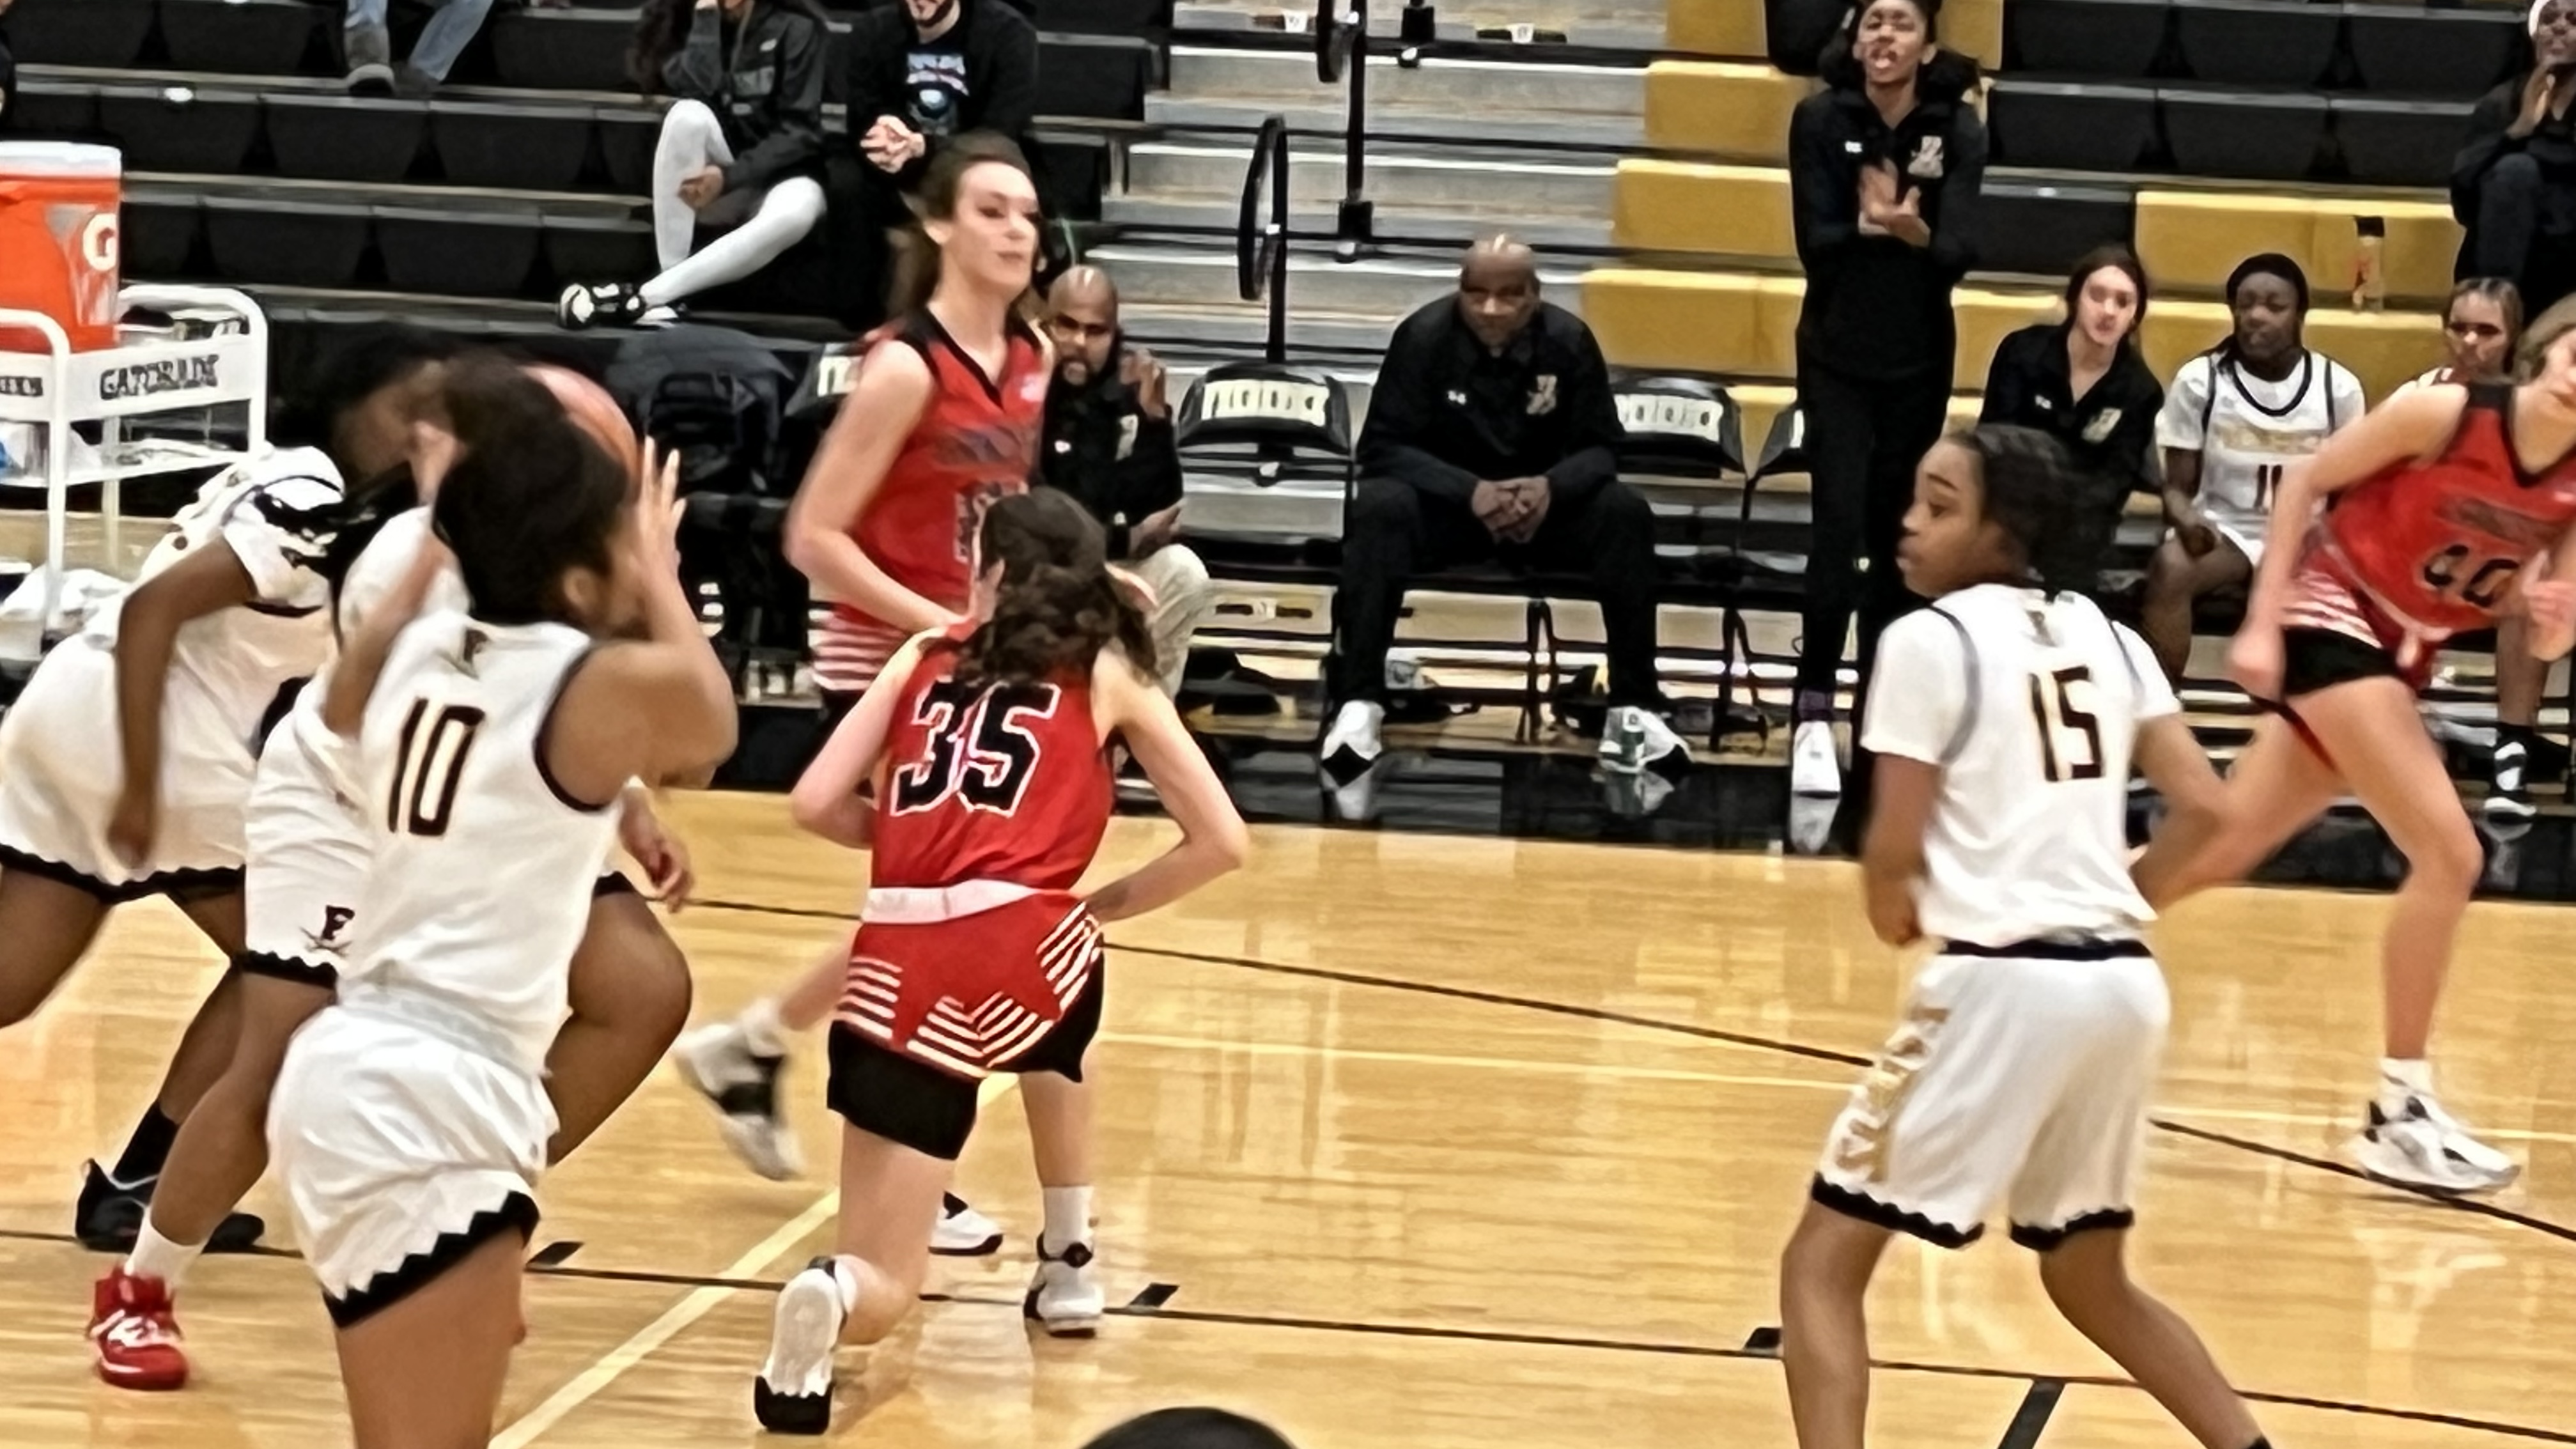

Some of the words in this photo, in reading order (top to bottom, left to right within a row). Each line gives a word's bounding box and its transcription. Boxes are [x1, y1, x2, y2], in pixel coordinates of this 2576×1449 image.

[82, 212, 118, 270] G
[387, 697, 486, 837] 10
[890, 675, 1062, 818] 35
[2028, 665, 2104, 782] 15
